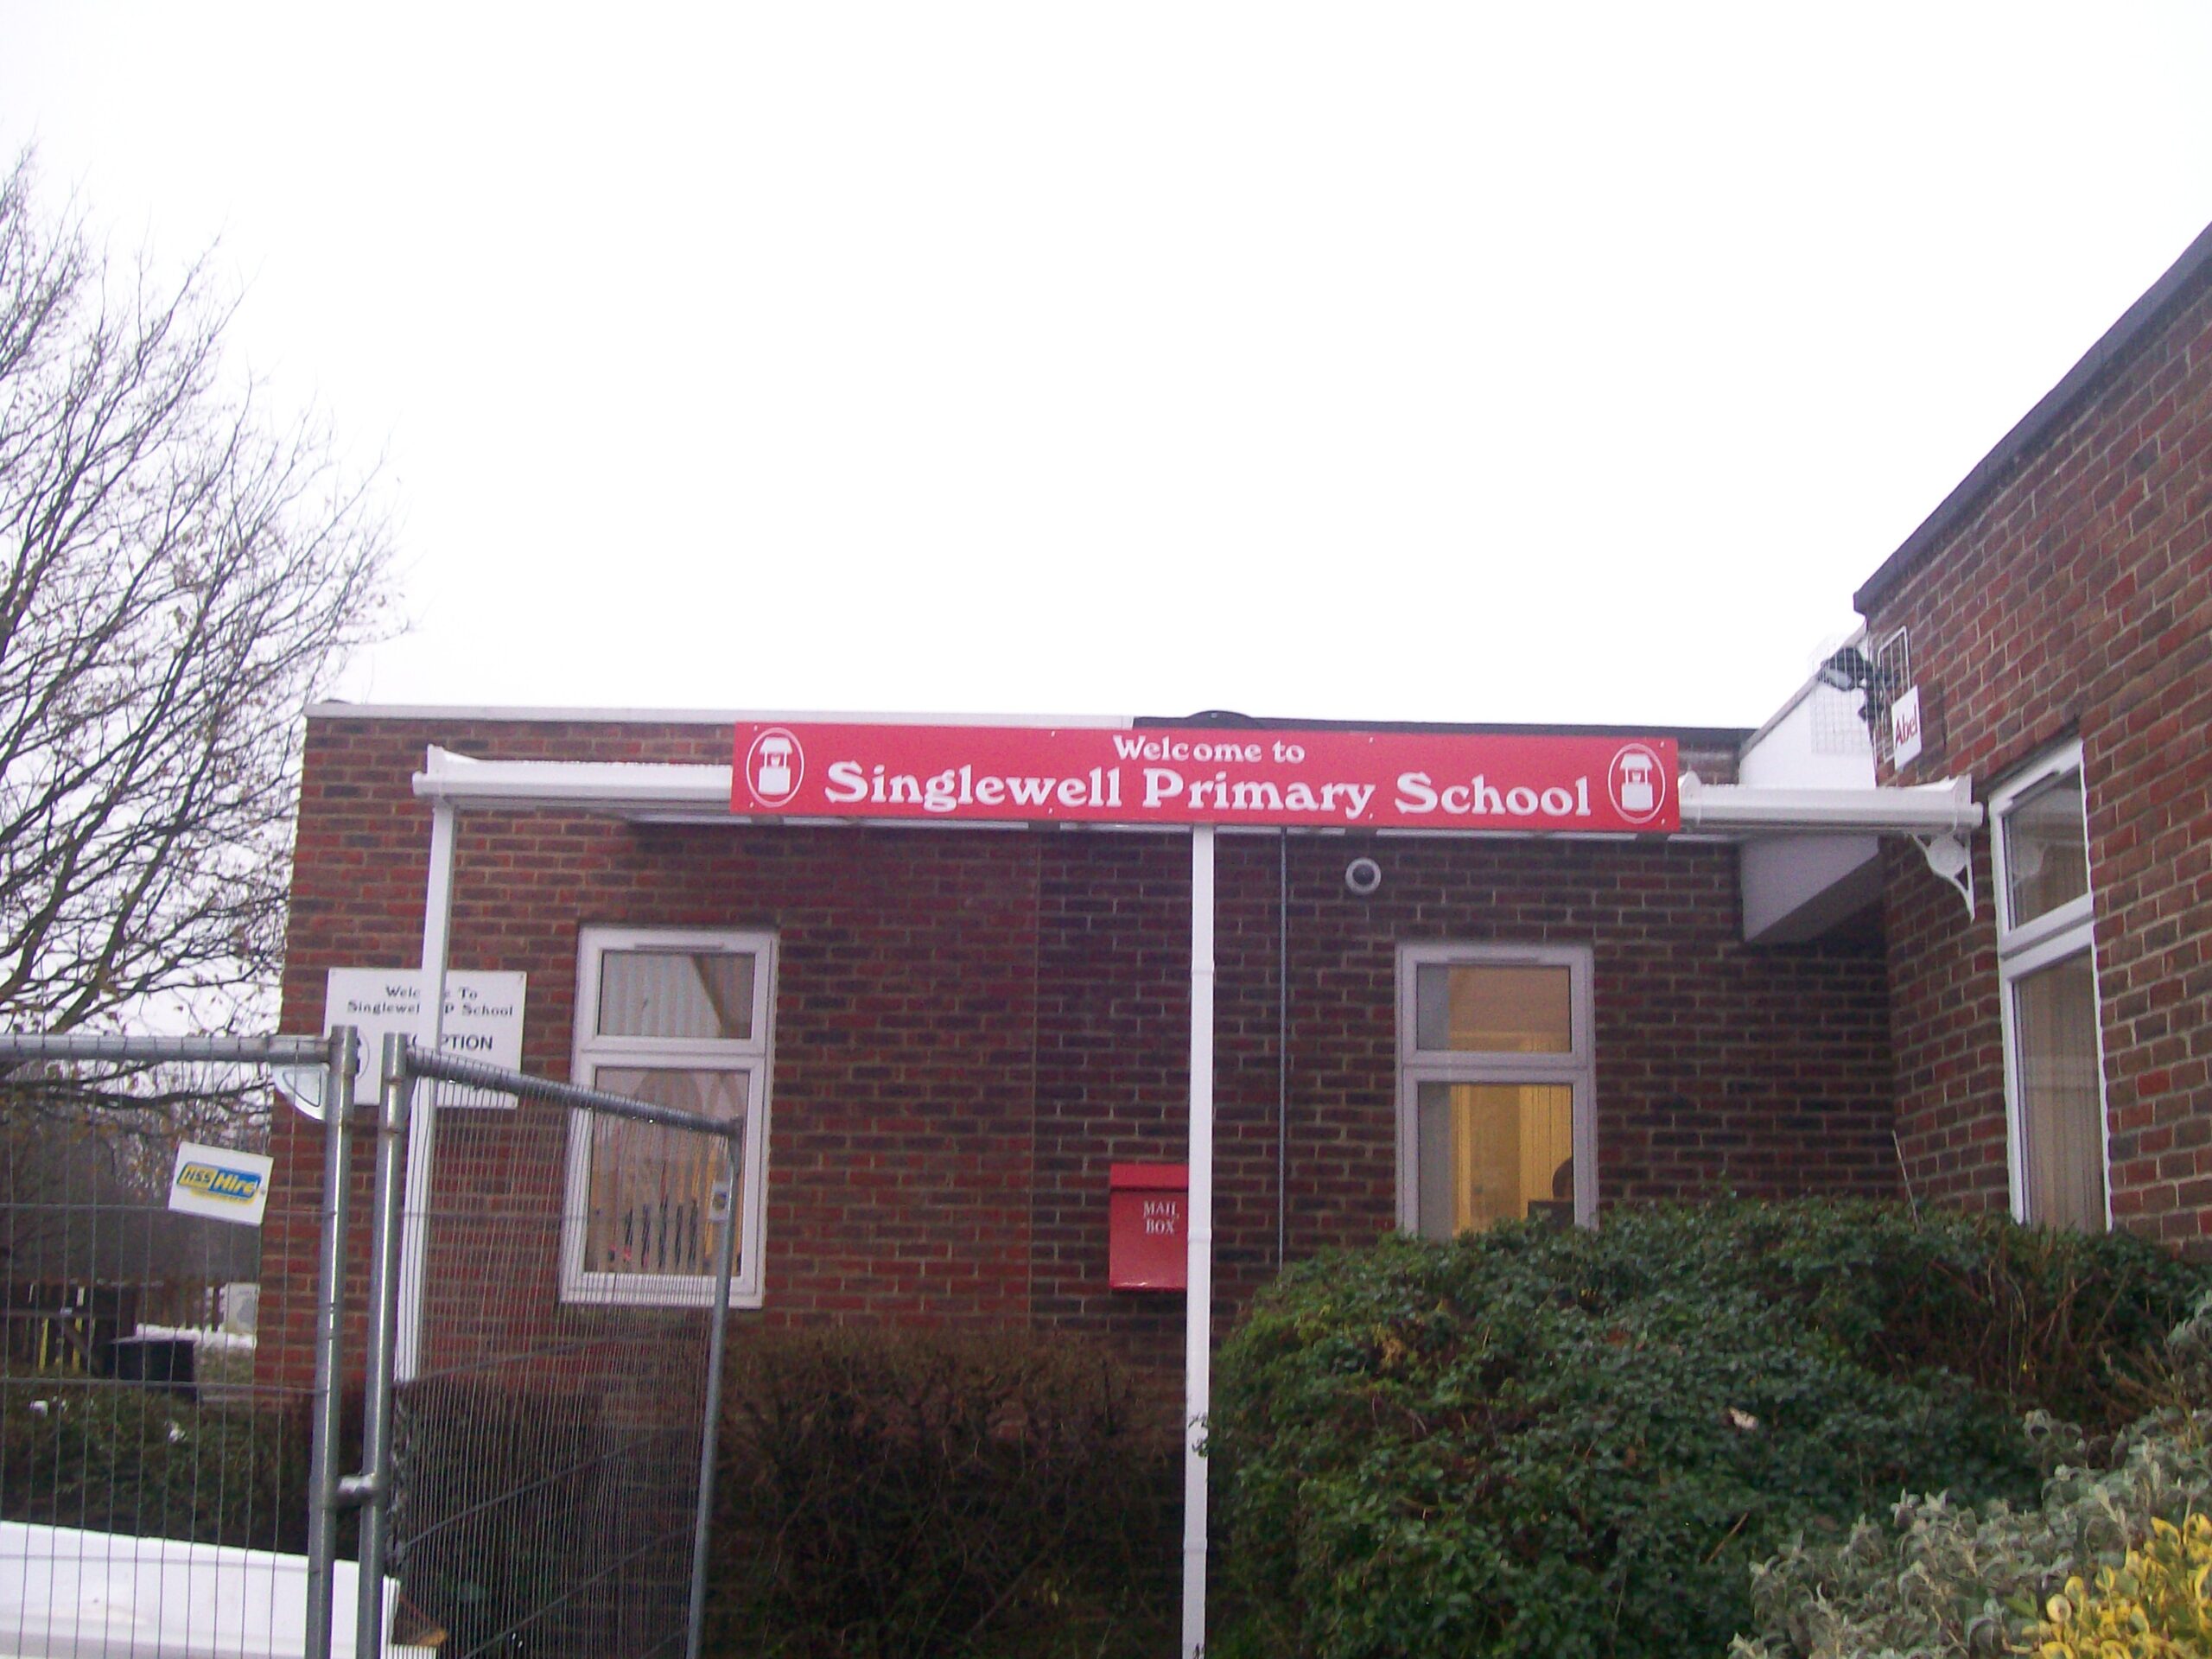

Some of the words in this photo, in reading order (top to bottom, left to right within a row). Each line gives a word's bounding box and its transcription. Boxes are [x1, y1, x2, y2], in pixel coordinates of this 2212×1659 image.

[1895, 703, 1918, 749] Abel
[1112, 734, 1263, 763] Welcome
[1272, 740, 1306, 764] to
[824, 760, 1122, 812] Singlewell
[1142, 767, 1376, 820] Primary
[1395, 770, 1592, 816] School
[458, 987, 478, 1001] To
[347, 1001, 421, 1014] Singlewel
[461, 1002, 512, 1016] School
[214, 1173, 255, 1194] Hire
[1143, 1200, 1178, 1217] MAIL
[1146, 1218, 1174, 1234] BOX
